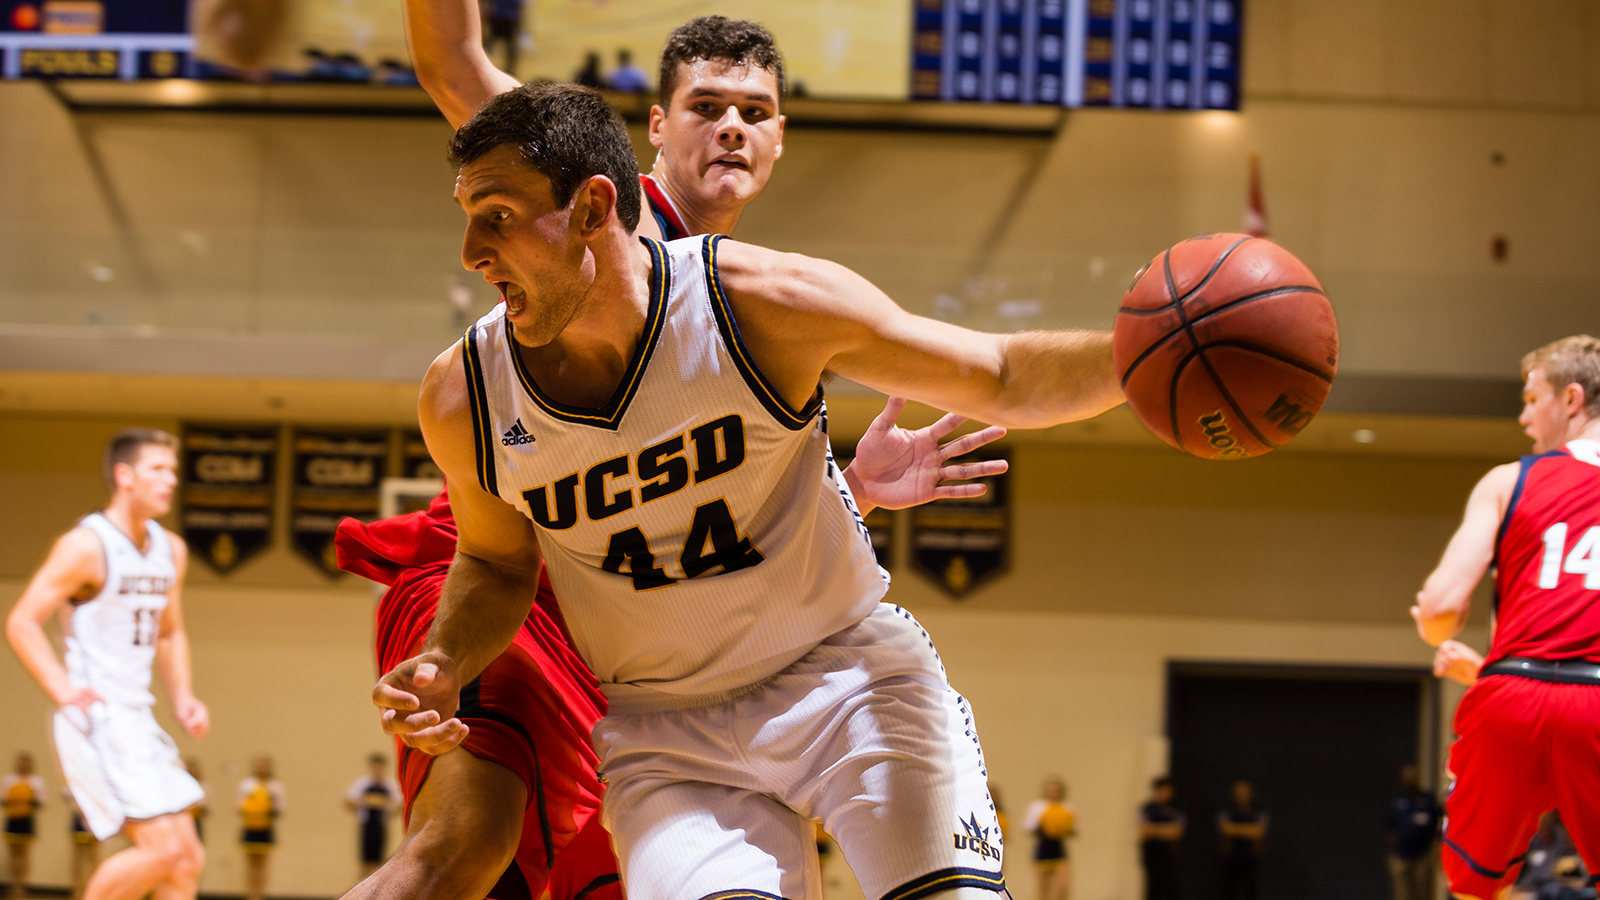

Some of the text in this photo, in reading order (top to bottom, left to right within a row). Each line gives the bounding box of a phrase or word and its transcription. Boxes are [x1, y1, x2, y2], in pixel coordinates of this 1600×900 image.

[502, 434, 536, 446] adidas
[520, 413, 747, 531] UCSD
[600, 495, 766, 592] 44
[1539, 521, 1600, 590] 14
[953, 833, 1000, 862] UCSD
